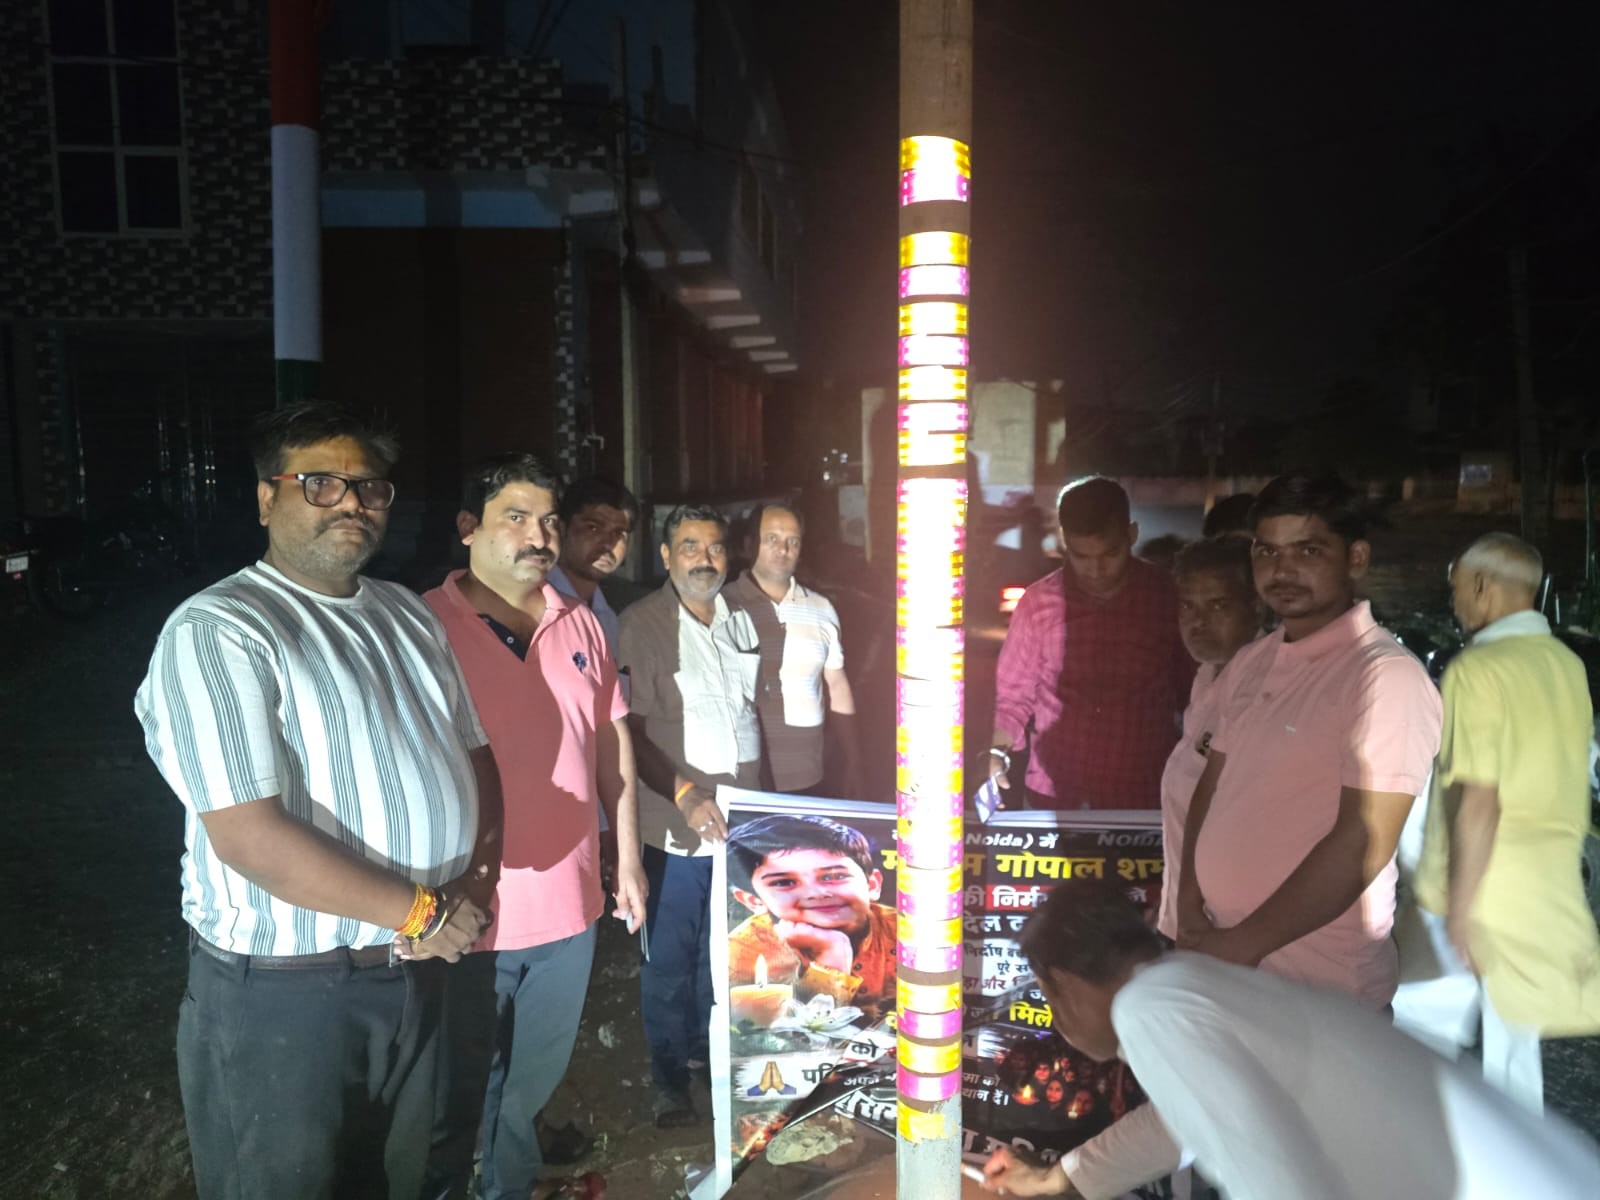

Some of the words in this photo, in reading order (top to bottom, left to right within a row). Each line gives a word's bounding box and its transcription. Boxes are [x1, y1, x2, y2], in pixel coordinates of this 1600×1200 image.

[1038, 832, 1060, 849] में
[995, 850, 1106, 880] गोपाल
[982, 975, 1007, 990] और
[850, 1038, 879, 1058] को
[982, 1073, 1001, 1087] को
